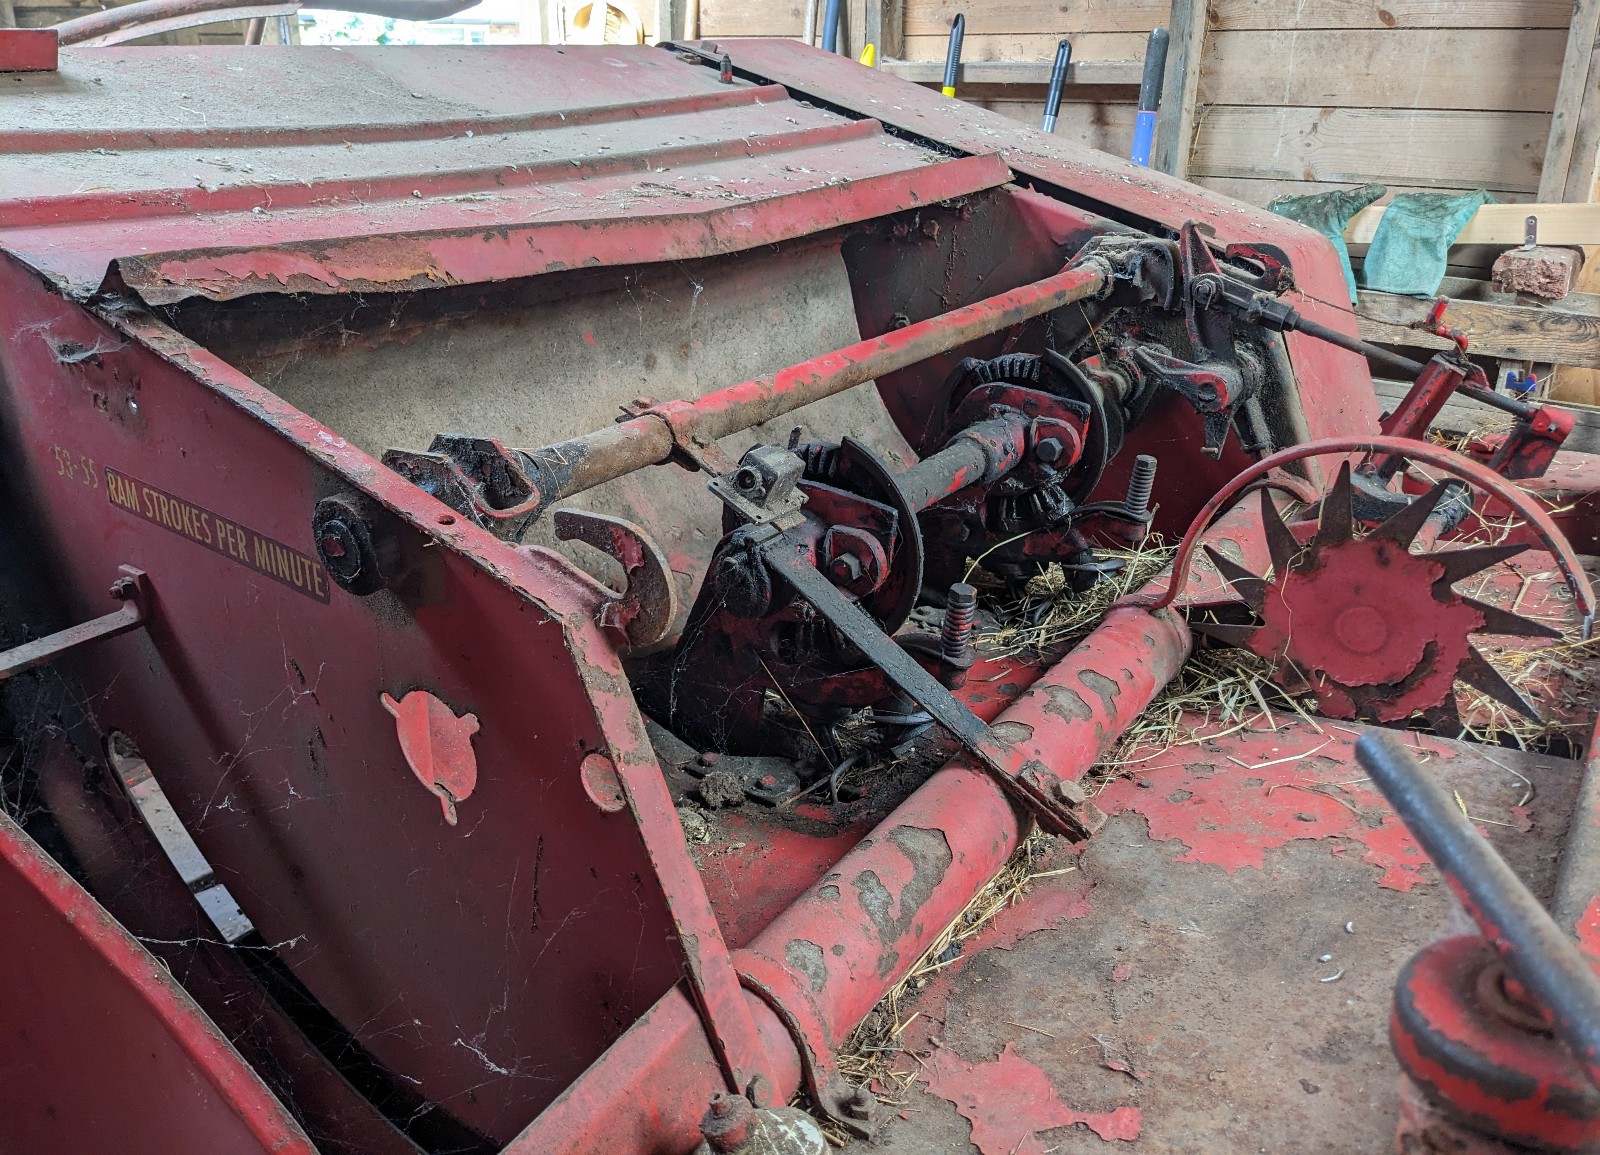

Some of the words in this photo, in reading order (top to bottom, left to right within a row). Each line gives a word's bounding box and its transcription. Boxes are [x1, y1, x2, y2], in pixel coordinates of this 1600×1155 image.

[107, 471, 140, 512] RAM
[143, 487, 212, 544] STROKES
[216, 519, 249, 562] PER
[254, 536, 325, 597] MINUTE
